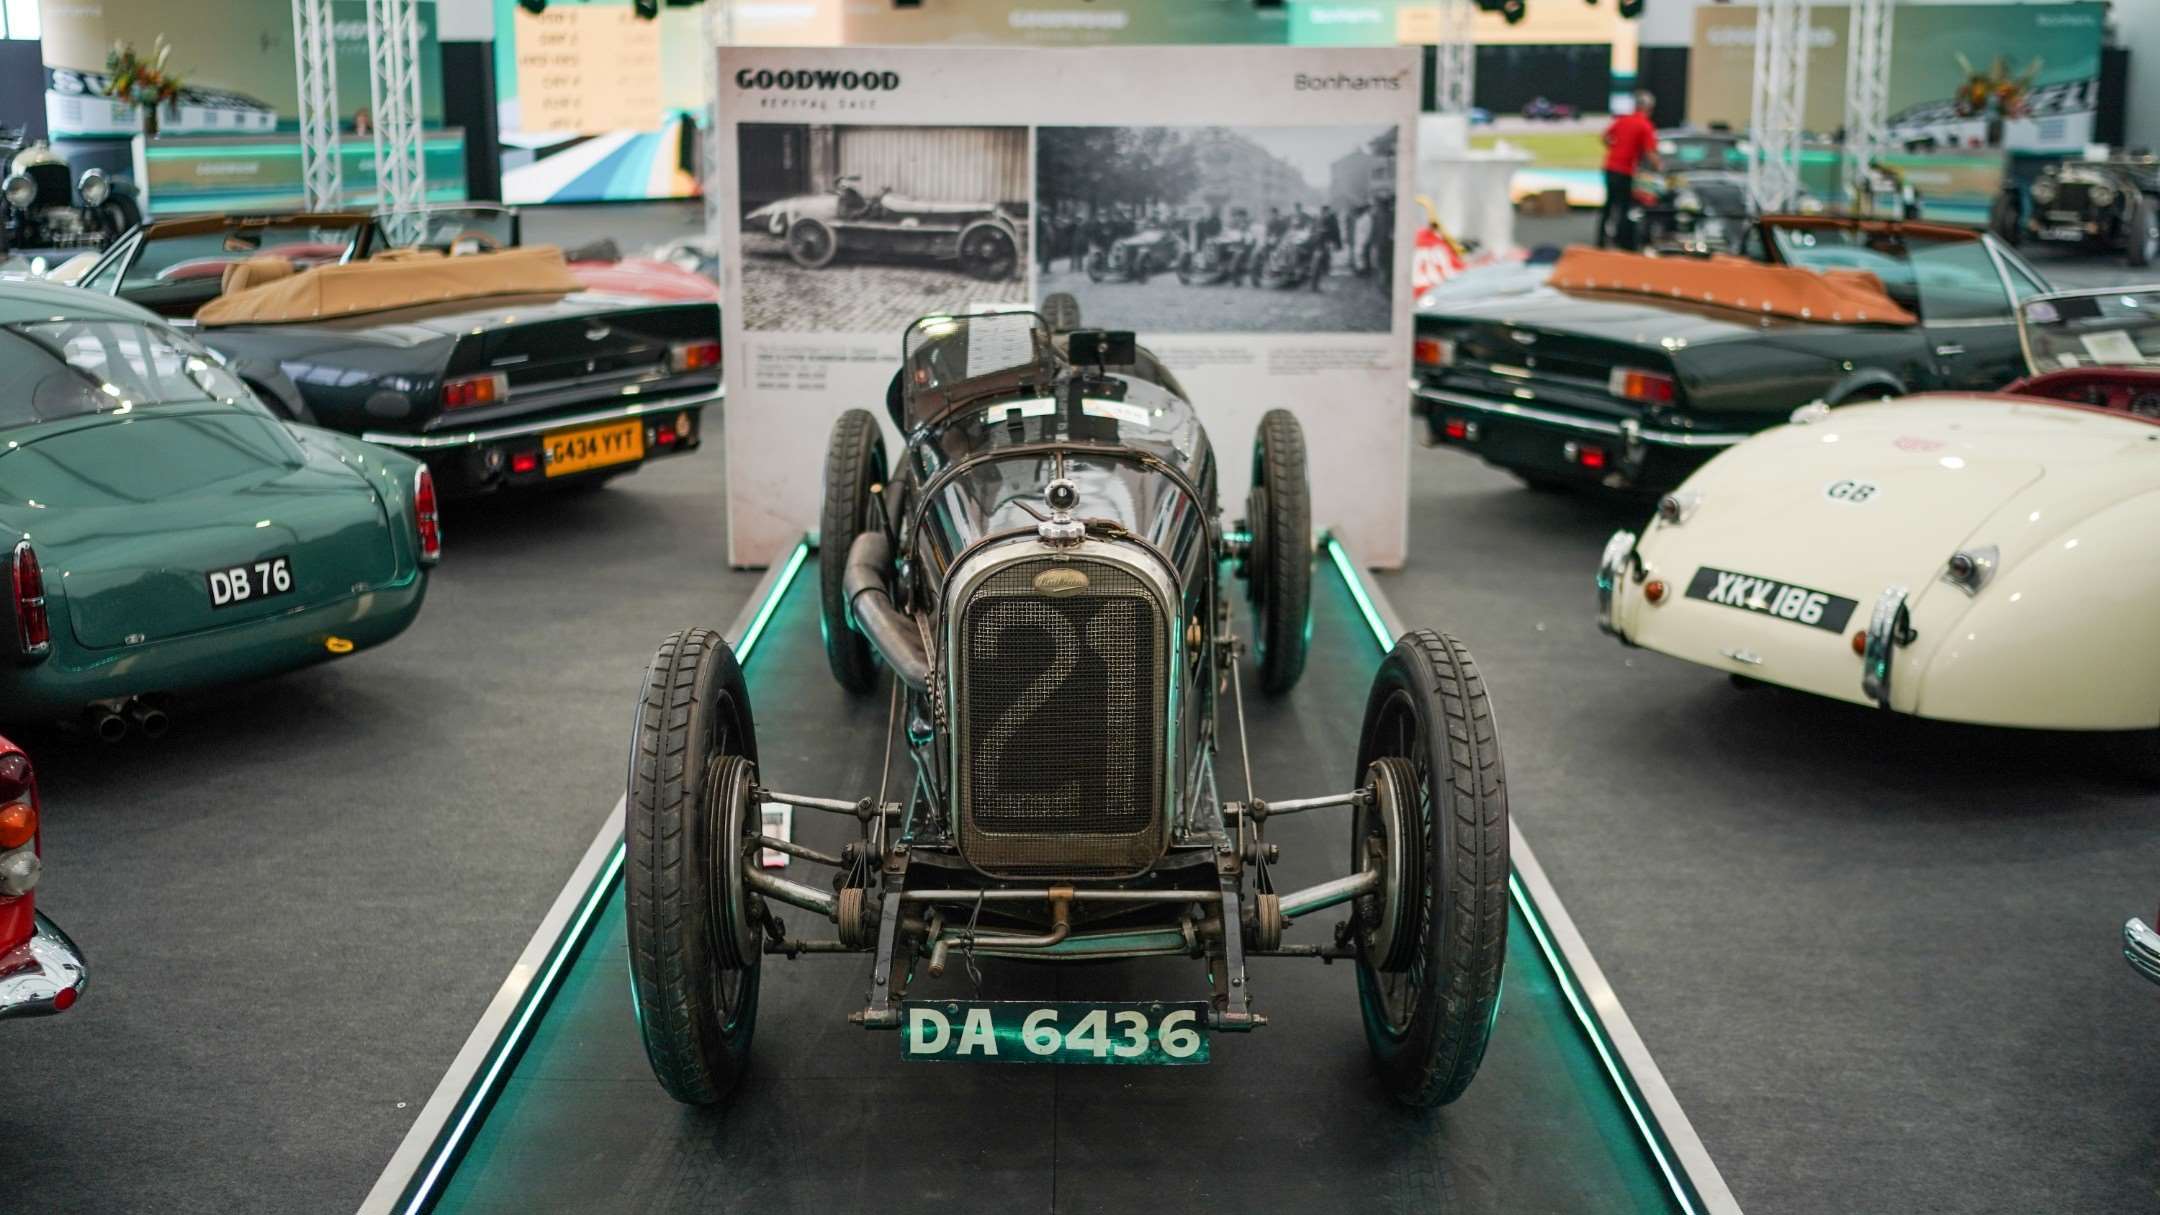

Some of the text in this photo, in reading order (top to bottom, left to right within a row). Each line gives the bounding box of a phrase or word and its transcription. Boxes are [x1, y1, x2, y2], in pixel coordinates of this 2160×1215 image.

[736, 69, 900, 91] GOODWOOD
[1294, 72, 1401, 91] Bonhams
[553, 429, 634, 464] G434 YYT
[1828, 480, 1875, 501] GB
[210, 558, 290, 605] DB 76
[1769, 585, 1829, 624] 186
[974, 600, 1137, 818] 21
[909, 1008, 1201, 1058] DA 6436
